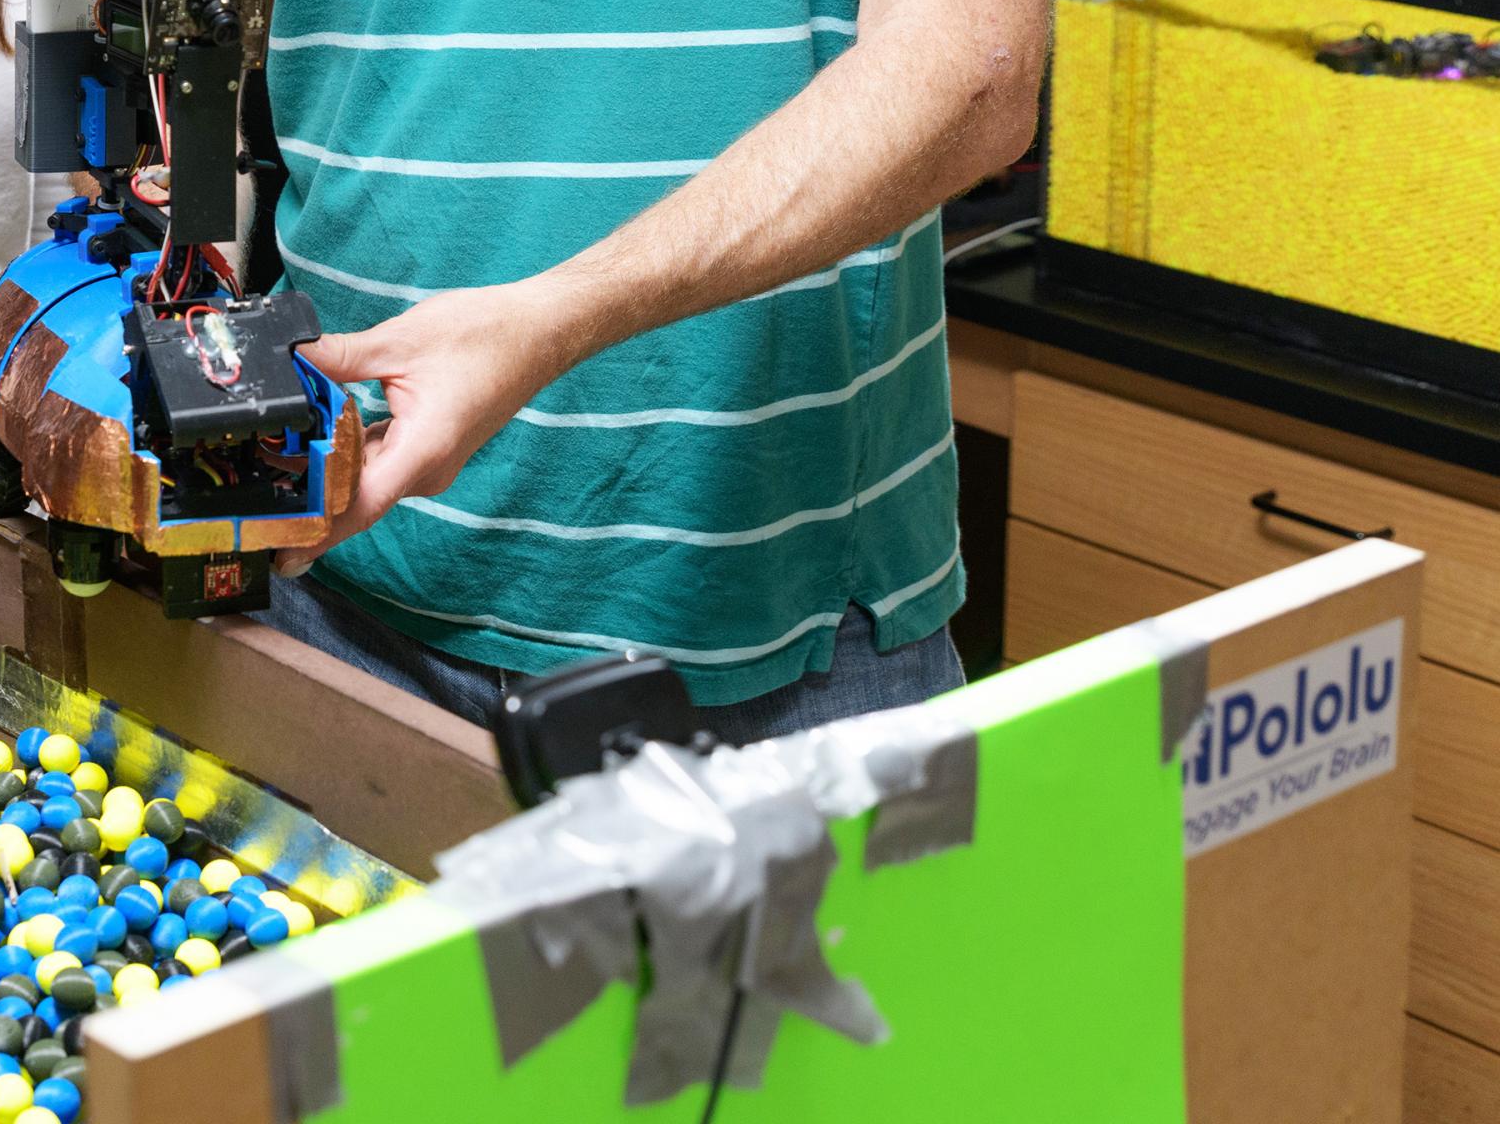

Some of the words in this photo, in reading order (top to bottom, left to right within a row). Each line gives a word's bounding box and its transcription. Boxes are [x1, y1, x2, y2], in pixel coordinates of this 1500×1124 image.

[1219, 645, 1394, 776] Pololu
[1185, 790, 1259, 845] ngage
[1268, 761, 1323, 805] Your
[1328, 734, 1391, 781] Brain
